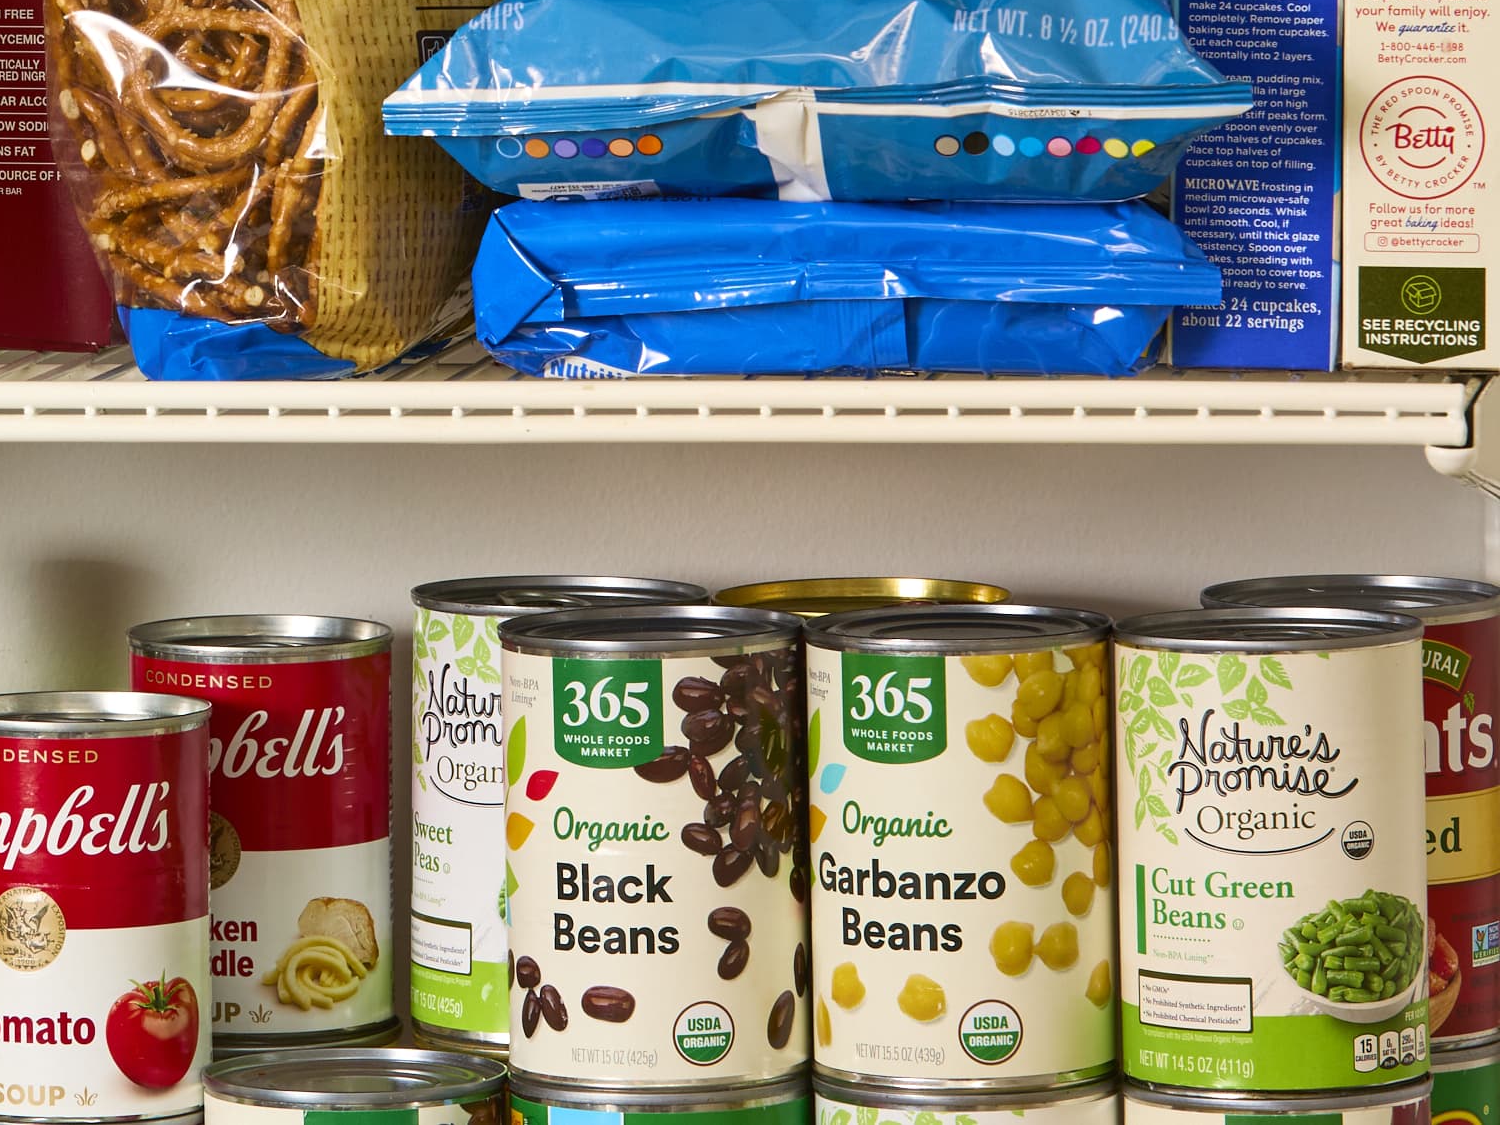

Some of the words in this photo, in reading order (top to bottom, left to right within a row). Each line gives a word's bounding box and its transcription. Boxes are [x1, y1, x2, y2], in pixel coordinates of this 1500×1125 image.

[4, 9, 33, 19] FREE
[14, 147, 35, 156] FAT
[1362, 319, 1391, 331] SEE
[1395, 319, 1480, 332] RECYCLING
[1366, 333, 1477, 345] INSTRUCTIONS
[146, 670, 272, 689] CONDENSED
[563, 677, 650, 728] 365
[564, 735, 603, 746] WHOLE
[609, 735, 650, 746] FOODS
[581, 746, 630, 758] MARKET
[1180, 709, 1340, 764] Nature's
[1168, 761, 1358, 813] Promise
[554, 807, 669, 852] Organic
[843, 801, 952, 846] Organic
[1197, 804, 1316, 839] Organic
[556, 862, 673, 903] Black
[819, 851, 1006, 901] Garbanzo
[1152, 868, 1196, 898] Cut
[1204, 872, 1294, 899] Green
[843, 908, 963, 952] Beans
[1152, 899, 1226, 930] Beans
[554, 913, 679, 954] Beans
[687, 1017, 721, 1032] USDA
[683, 1036, 726, 1048] ORGANIC
[1172, 1051, 1194, 1071] 14.5
[1198, 1055, 1212, 1073] OZ
[1216, 1057, 1254, 1077] (411g)
